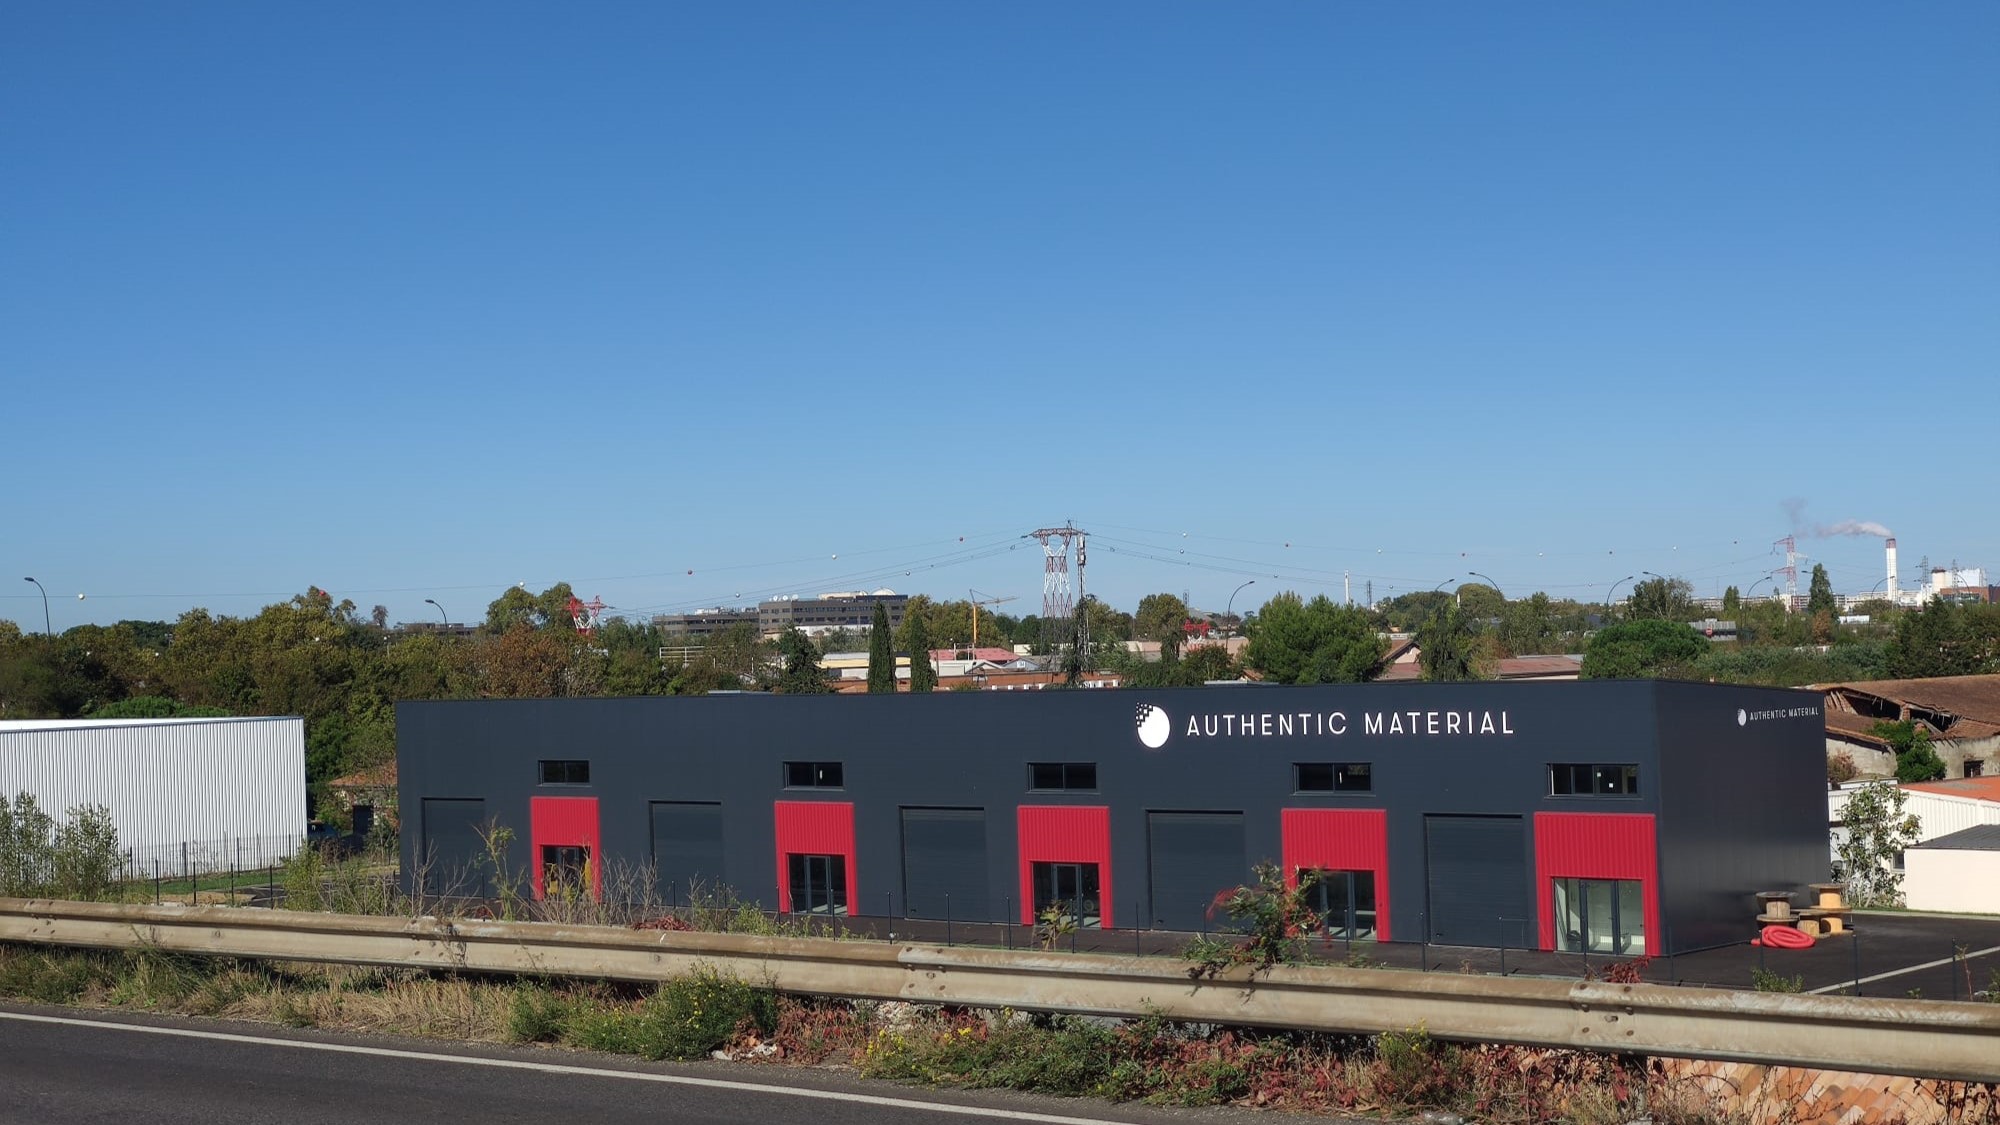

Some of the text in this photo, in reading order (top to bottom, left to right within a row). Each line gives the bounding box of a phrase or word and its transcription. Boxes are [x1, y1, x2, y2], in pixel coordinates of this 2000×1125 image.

[1186, 711, 1514, 736] AUTHENTIC MATERIAL
[1749, 707, 1819, 721] AUTHENTIC MATERIAL
